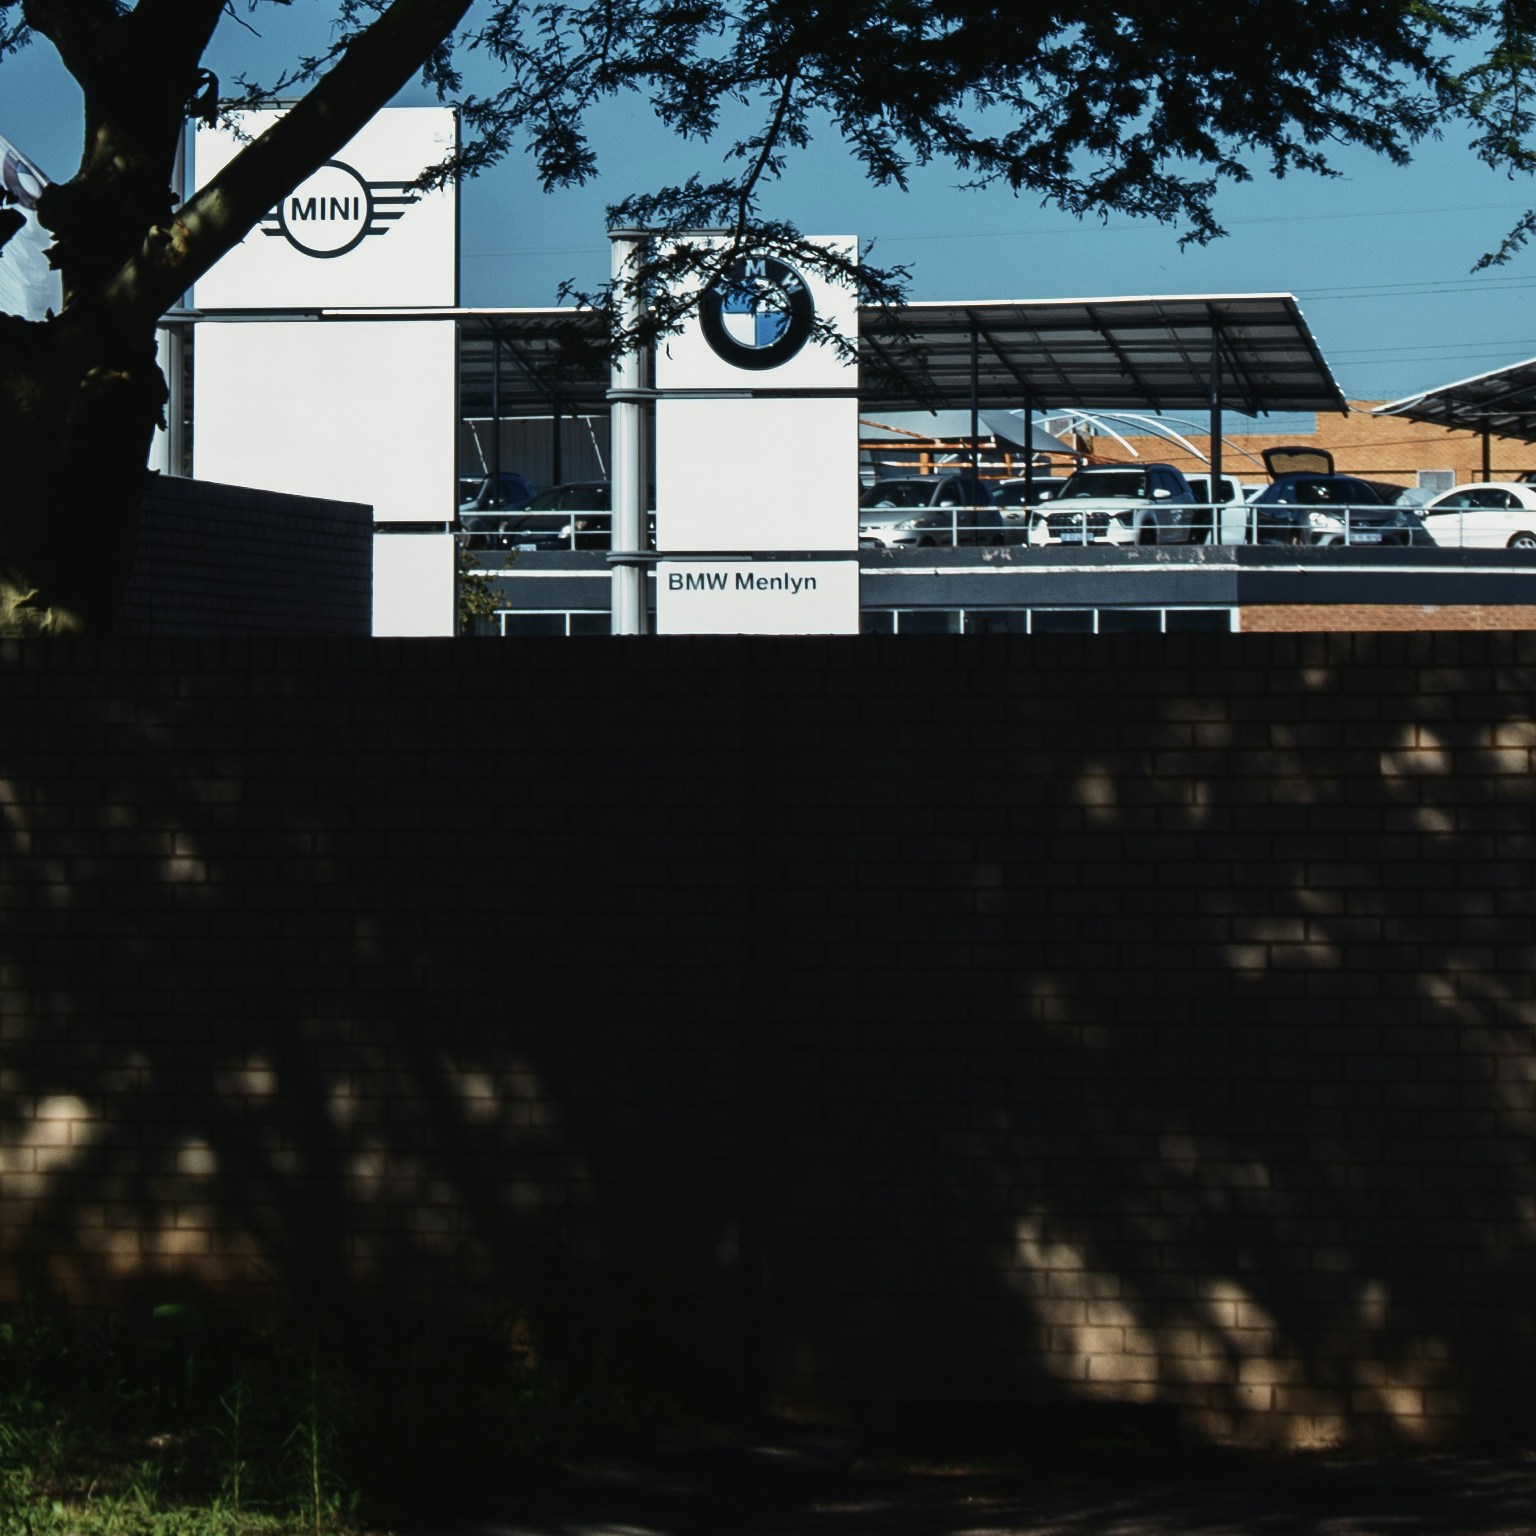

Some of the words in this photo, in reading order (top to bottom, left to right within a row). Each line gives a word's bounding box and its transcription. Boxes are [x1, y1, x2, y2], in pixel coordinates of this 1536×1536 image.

[291, 196, 360, 221] MINI
[668, 572, 728, 591] BMW
[735, 572, 817, 595] Menlyn
